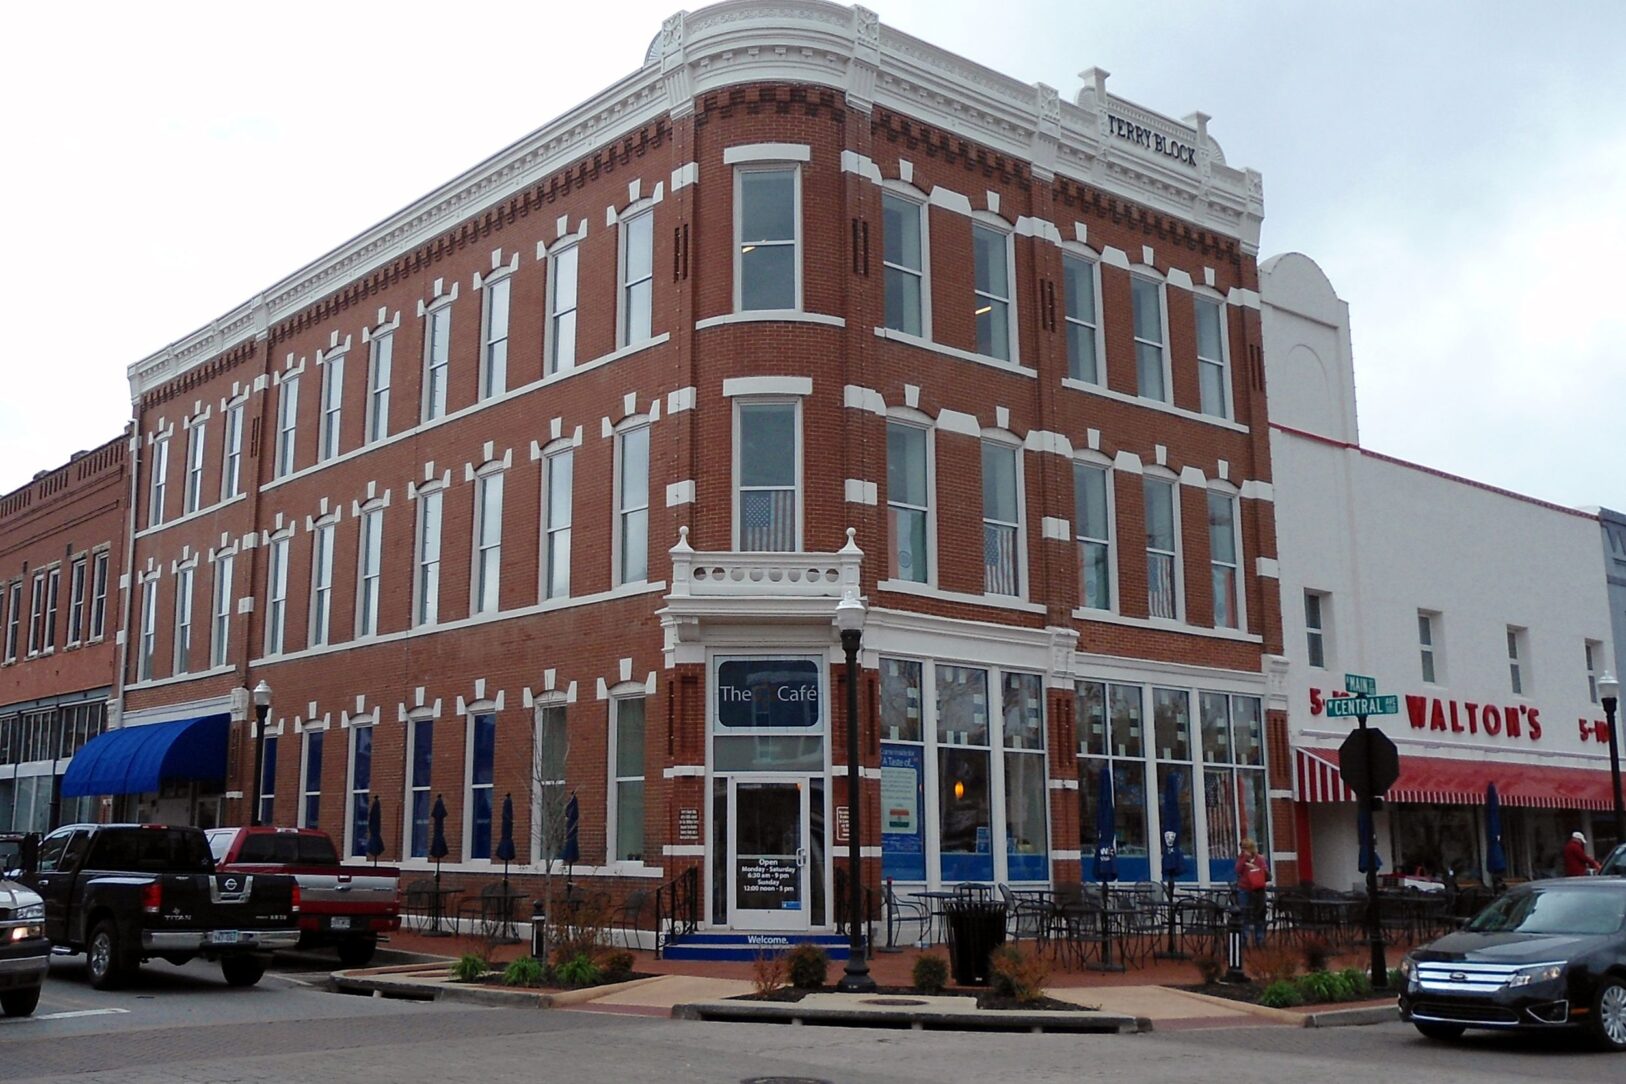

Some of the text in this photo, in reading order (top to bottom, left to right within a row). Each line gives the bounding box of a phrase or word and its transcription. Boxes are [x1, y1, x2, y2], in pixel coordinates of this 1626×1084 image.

[1108, 114, 1197, 167] TERRY BLOCK
[720, 685, 817, 701] The Café
[1349, 677, 1367, 693] MAIN
[1334, 698, 1383, 715] CENTRAL
[1405, 694, 1542, 741] WALTON'S
[759, 858, 778, 866] Open
[747, 935, 789, 944] Welcome.
